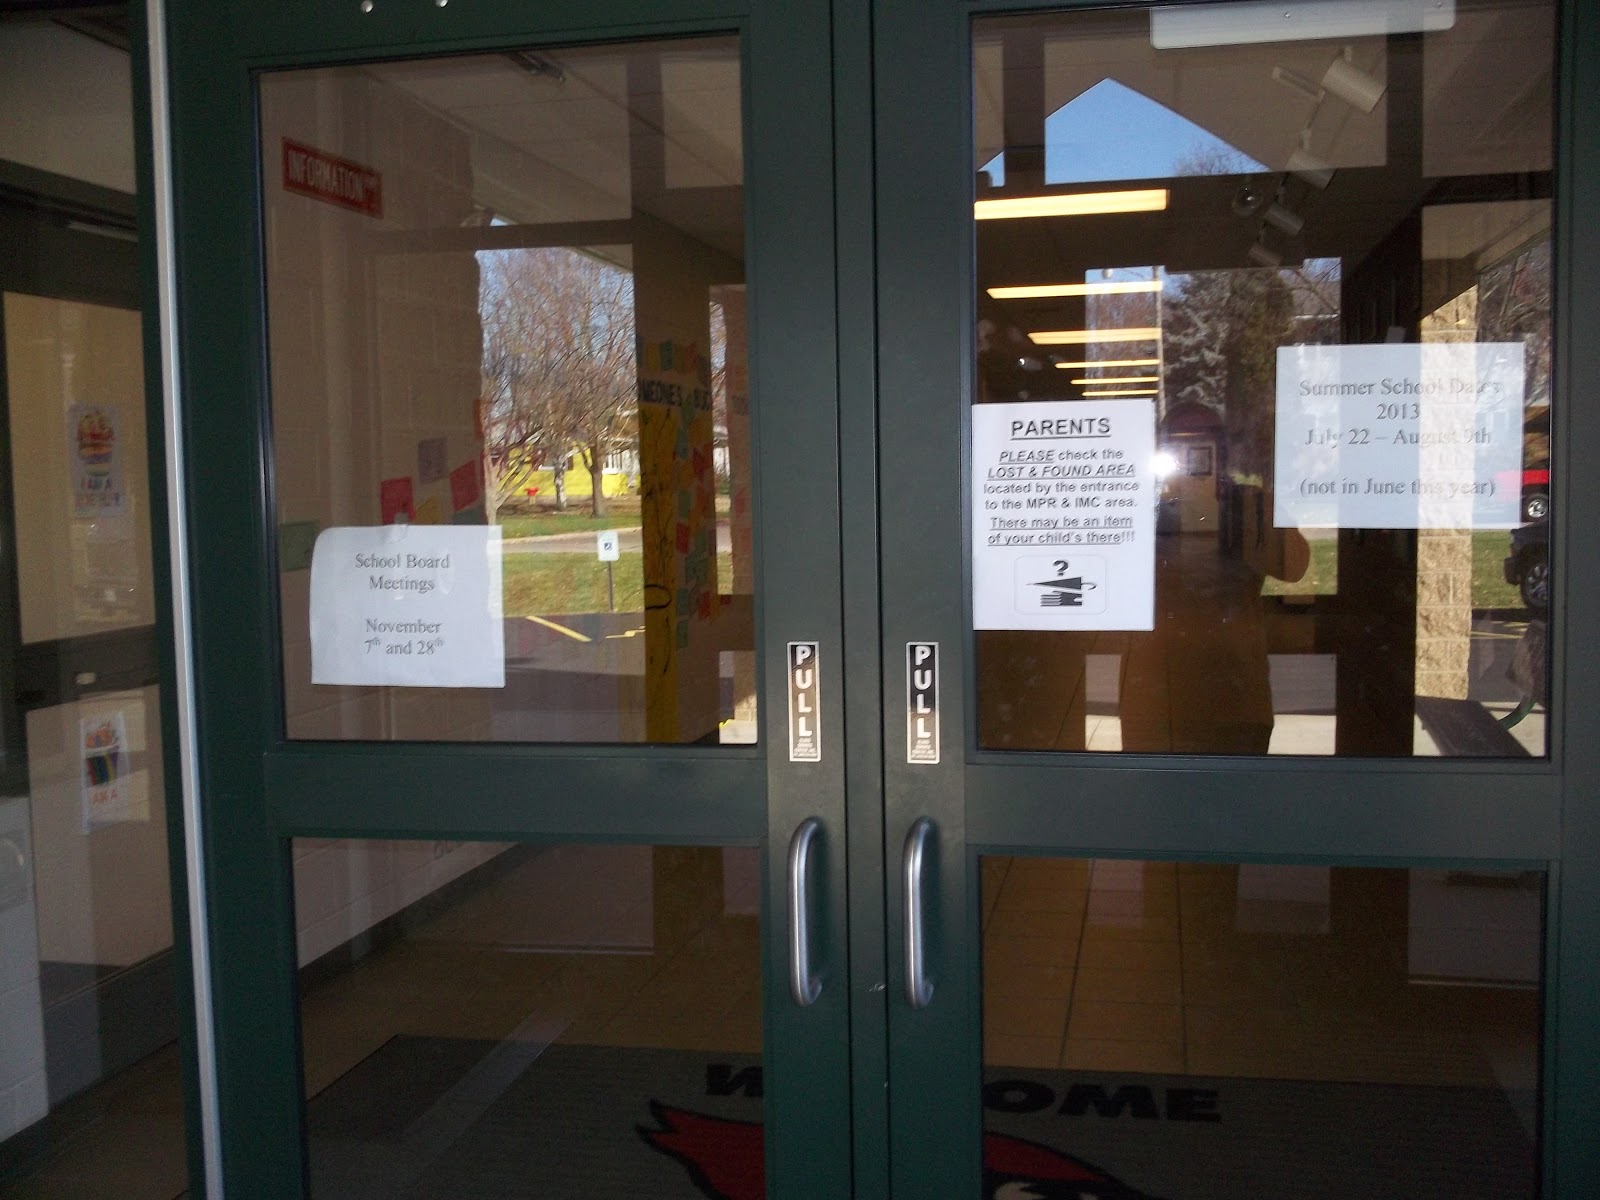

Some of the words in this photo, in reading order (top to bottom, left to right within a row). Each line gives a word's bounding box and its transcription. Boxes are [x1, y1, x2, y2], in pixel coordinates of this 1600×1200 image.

[1299, 378, 1376, 397] Summer
[1381, 377, 1442, 396] School
[1448, 376, 1500, 395] Dates
[1376, 403, 1420, 420] 2013
[1011, 418, 1111, 438] PARENTS
[1305, 428, 1342, 449] July
[1348, 428, 1370, 445] 22
[1392, 429, 1459, 447] August
[1463, 427, 1491, 445] 9th
[999, 449, 1056, 463] PLEASE
[1058, 449, 1097, 461] check
[1102, 448, 1123, 460] the
[987, 466, 1025, 479] LOST
[1028, 466, 1038, 478] &
[1041, 465, 1092, 478] FOUND
[1095, 463, 1136, 476] AREA
[984, 482, 1031, 495] located
[1035, 482, 1052, 495] by
[1055, 481, 1076, 493] the
[1080, 480, 1140, 492] entrance
[1299, 478, 1336, 497] (not
[1342, 477, 1359, 495] in
[1364, 478, 1406, 496] June
[1411, 477, 1440, 495] this
[1449, 478, 1496, 498] year)
[985, 499, 998, 511] to
[1001, 498, 1022, 510] the
[1026, 498, 1056, 509] MPR
[1061, 497, 1071, 508] &
[1075, 496, 1101, 508] IMC
[1105, 497, 1138, 508] area.
[990, 517, 1027, 529] There
[1031, 517, 1060, 529] may
[1063, 516, 1079, 528] be
[1083, 516, 1099, 528] an
[1103, 515, 1133, 527] item
[988, 532, 1002, 545] of
[1005, 534, 1034, 546] your
[1038, 532, 1082, 544] child's
[1086, 531, 1136, 543] there!!!
[355, 552, 400, 569] School
[406, 553, 450, 569] Board
[369, 575, 435, 594] Meetings
[365, 618, 443, 634] November
[364, 637, 381, 655] 7th
[386, 639, 412, 655] and
[417, 637, 444, 655] 28th
[795, 645, 813, 737] PULL
[914, 645, 932, 739] PULL
